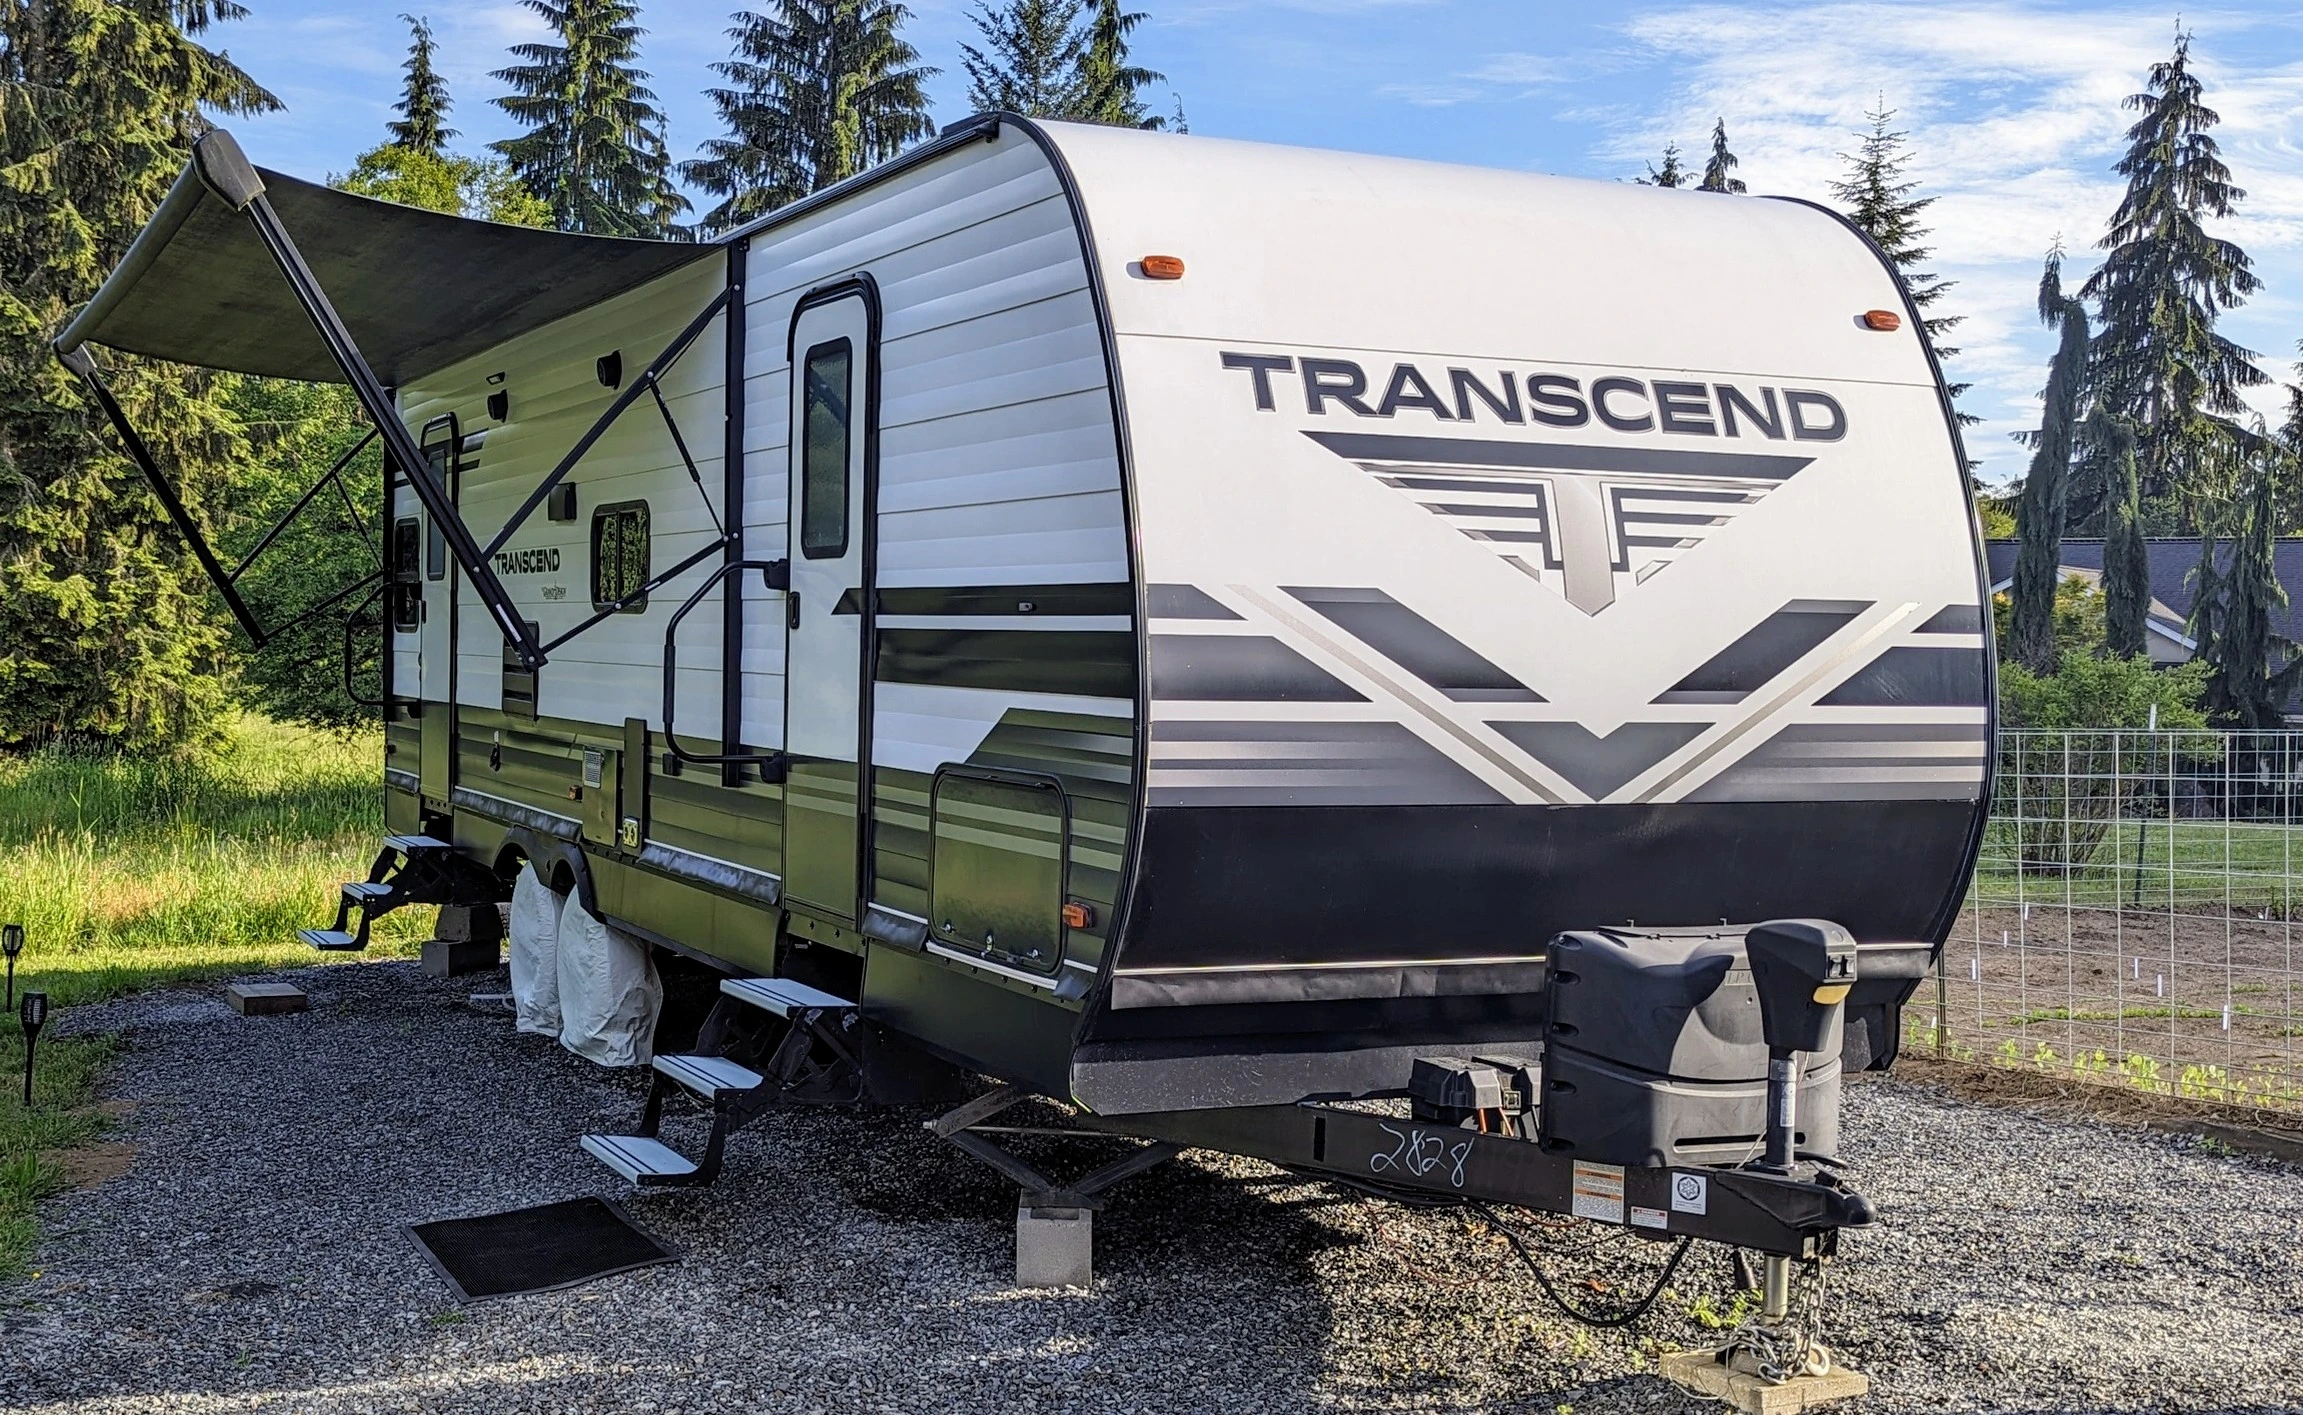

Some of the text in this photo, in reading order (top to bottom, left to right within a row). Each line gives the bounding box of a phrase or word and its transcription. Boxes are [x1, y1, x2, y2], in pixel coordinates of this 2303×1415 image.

[1219, 351, 1849, 443] TRANSCEND
[495, 548, 560, 575] TRANSCEND
[1370, 1123, 1475, 1188] 2828
